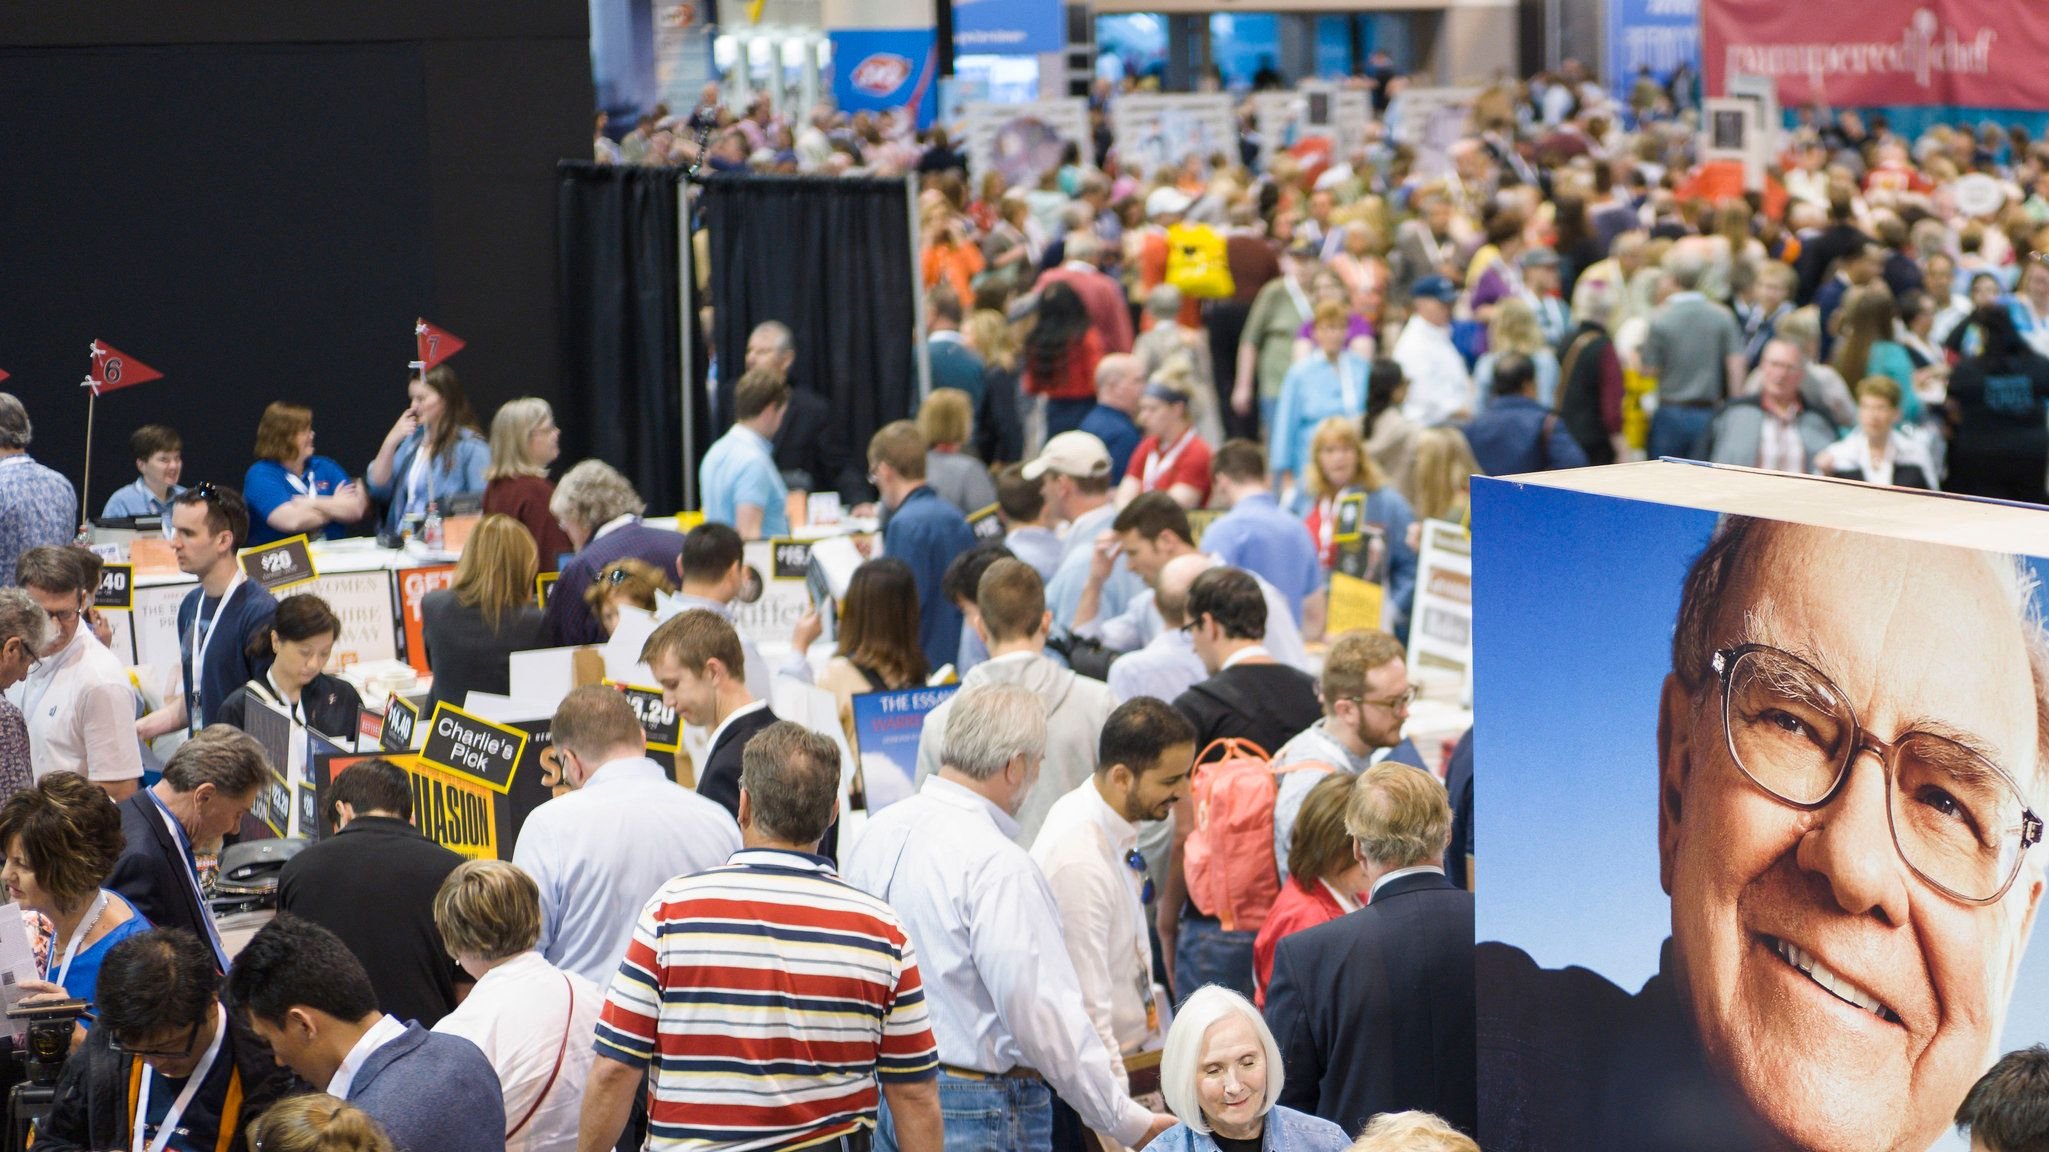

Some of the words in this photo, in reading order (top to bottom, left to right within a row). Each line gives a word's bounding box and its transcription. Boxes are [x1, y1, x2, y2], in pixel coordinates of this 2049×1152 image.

[428, 334, 441, 361] 7
[103, 358, 122, 384] 6
[261, 549, 293, 573] $20
[100, 572, 126, 591] .40
[143, 603, 165, 617] THE
[626, 695, 676, 726] 3.20
[880, 693, 911, 713] THE
[438, 717, 514, 761] Charlie's
[450, 742, 490, 773] Pick
